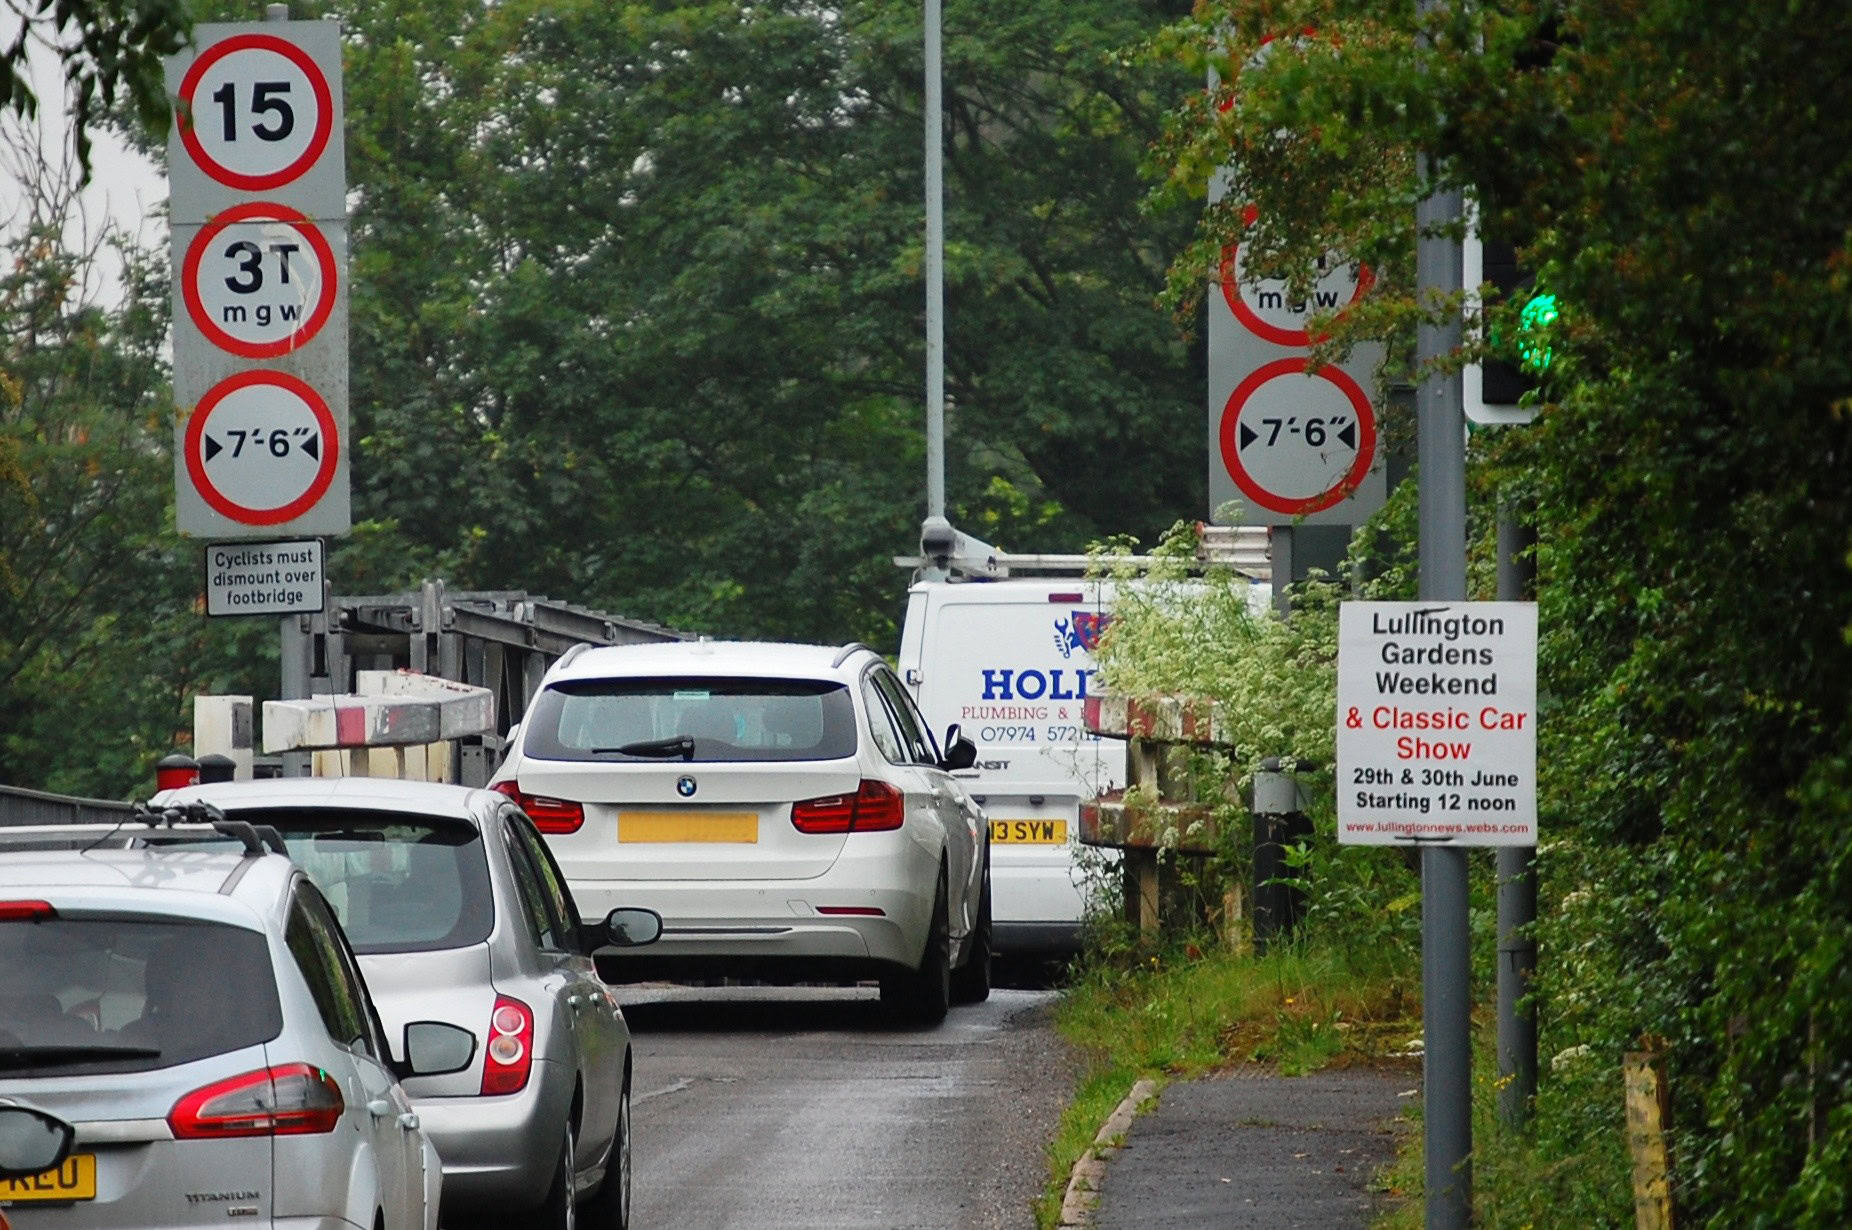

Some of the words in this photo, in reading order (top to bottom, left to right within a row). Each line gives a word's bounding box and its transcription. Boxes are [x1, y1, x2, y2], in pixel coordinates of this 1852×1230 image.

[213, 82, 295, 142] 15
[215, 551, 273, 569] Cyclists
[277, 549, 313, 564] must
[213, 570, 280, 586] dismount
[285, 571, 315, 583] over
[227, 589, 303, 605] footbridge
[1373, 612, 1504, 641] Lullington
[1381, 642, 1494, 665] Gardens
[1376, 672, 1497, 695] Weekend
[962, 706, 1048, 720] PLUMBING
[1058, 707, 1069, 720] &
[1346, 706, 1363, 729] &
[1372, 706, 1470, 730] Classic
[1479, 707, 1528, 730] Car
[1397, 736, 1471, 760] Show
[1354, 768, 1394, 785] 29th
[1401, 769, 1414, 785] &
[1421, 769, 1464, 787] 30th
[1471, 770, 1519, 788] June
[1356, 791, 1431, 813] Starting
[1438, 794, 1461, 810] 12
[1468, 797, 1516, 811] noon
[1015, 822, 1054, 840] SYW
[1346, 822, 1529, 835] www.lullingtonnews.webs.com
[185, 1191, 260, 1203] TITANIUM
